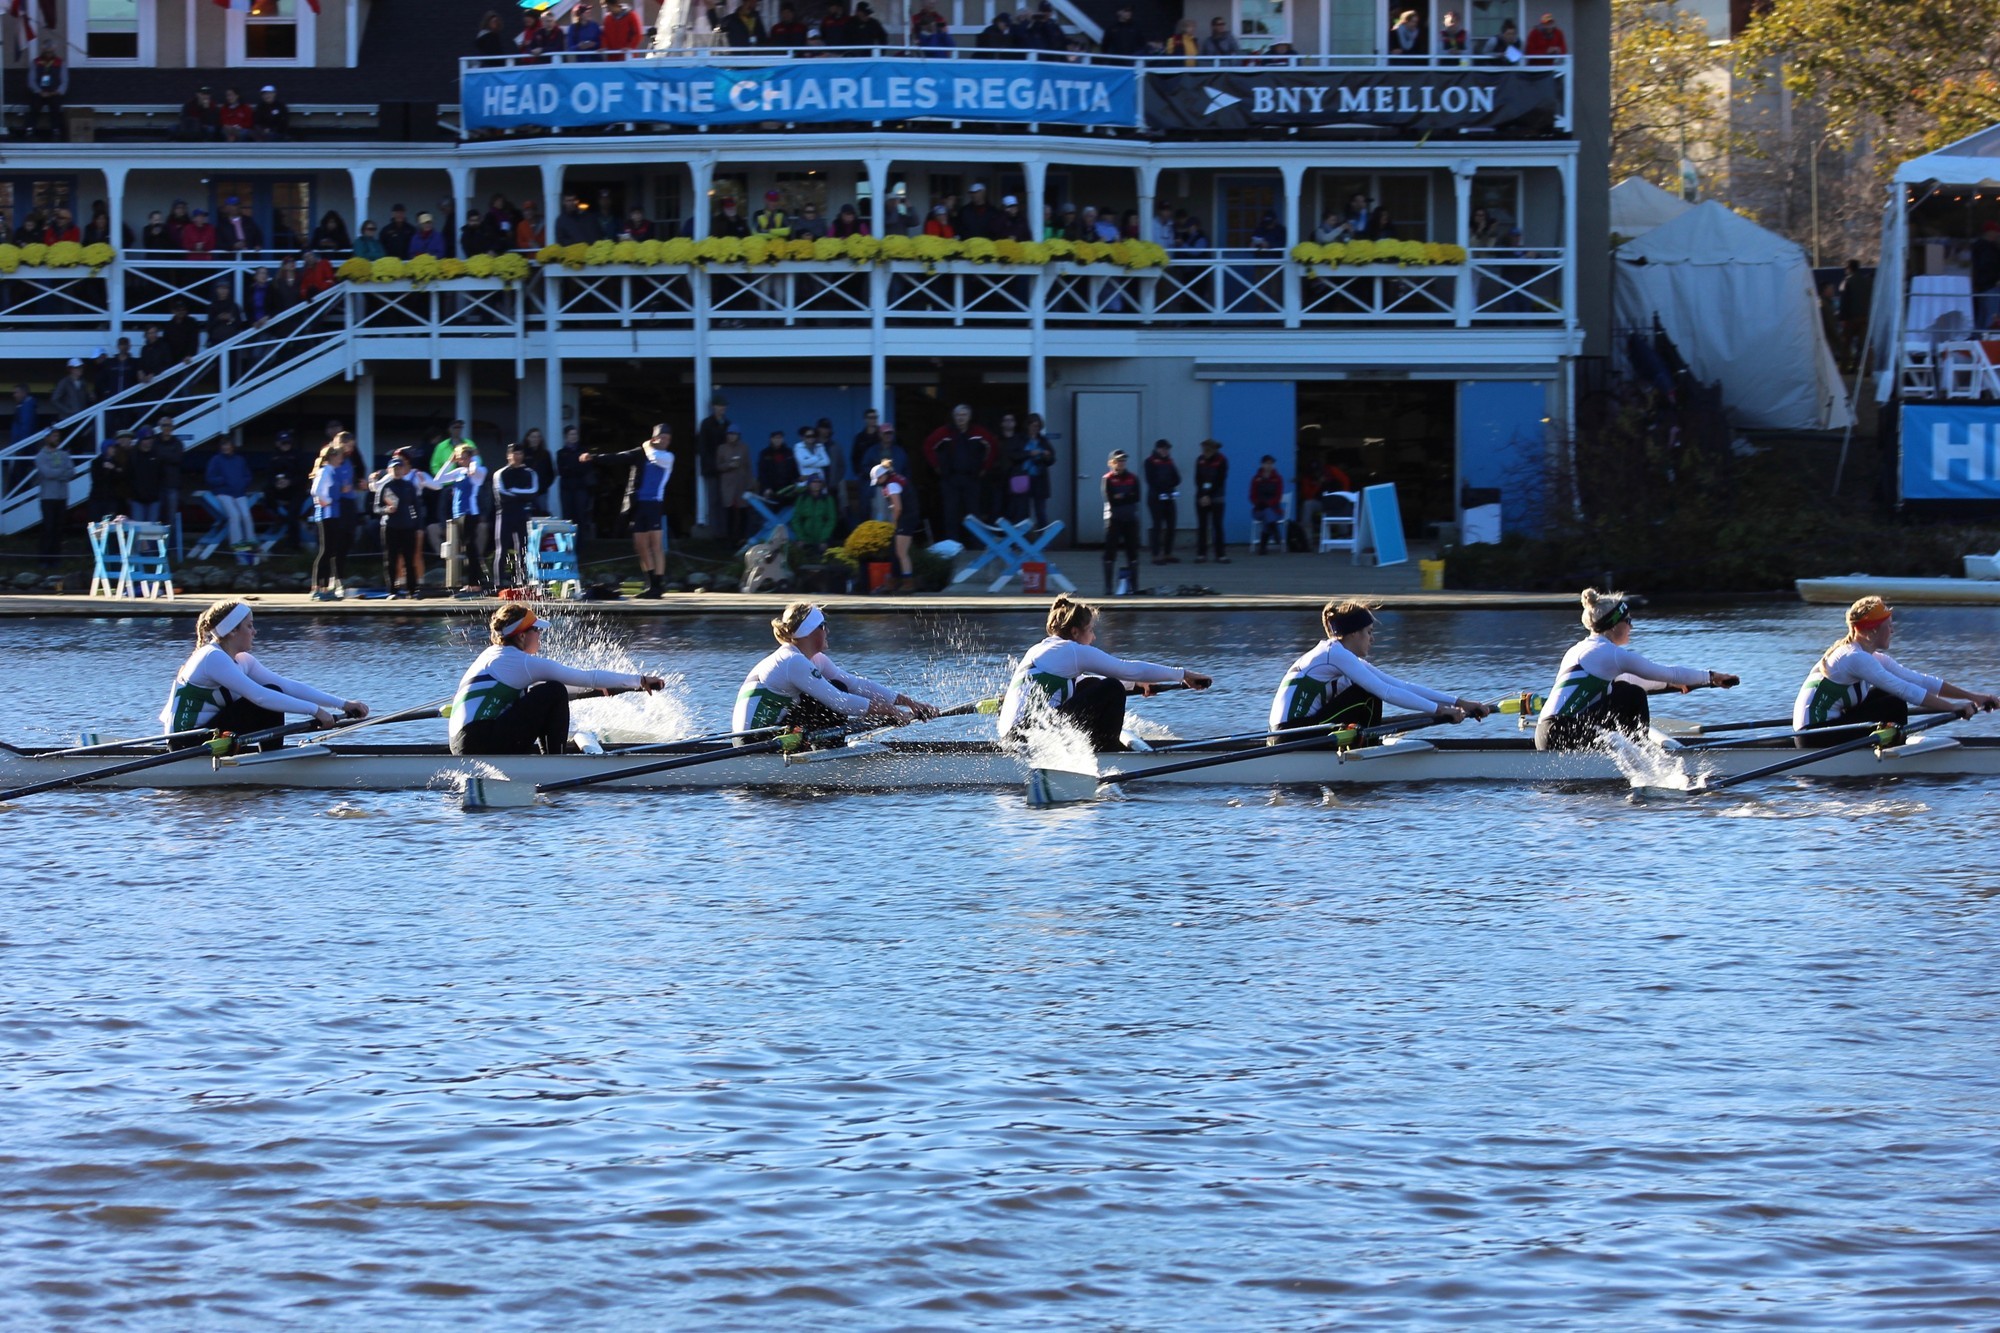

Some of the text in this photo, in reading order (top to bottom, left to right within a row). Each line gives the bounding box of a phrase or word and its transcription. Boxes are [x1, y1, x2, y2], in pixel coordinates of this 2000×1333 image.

[483, 76, 1112, 118] HEAD OF THE CHARLES REGATTA
[1251, 85, 1497, 114] BNY MELLON
[1931, 422, 2000, 481] H
